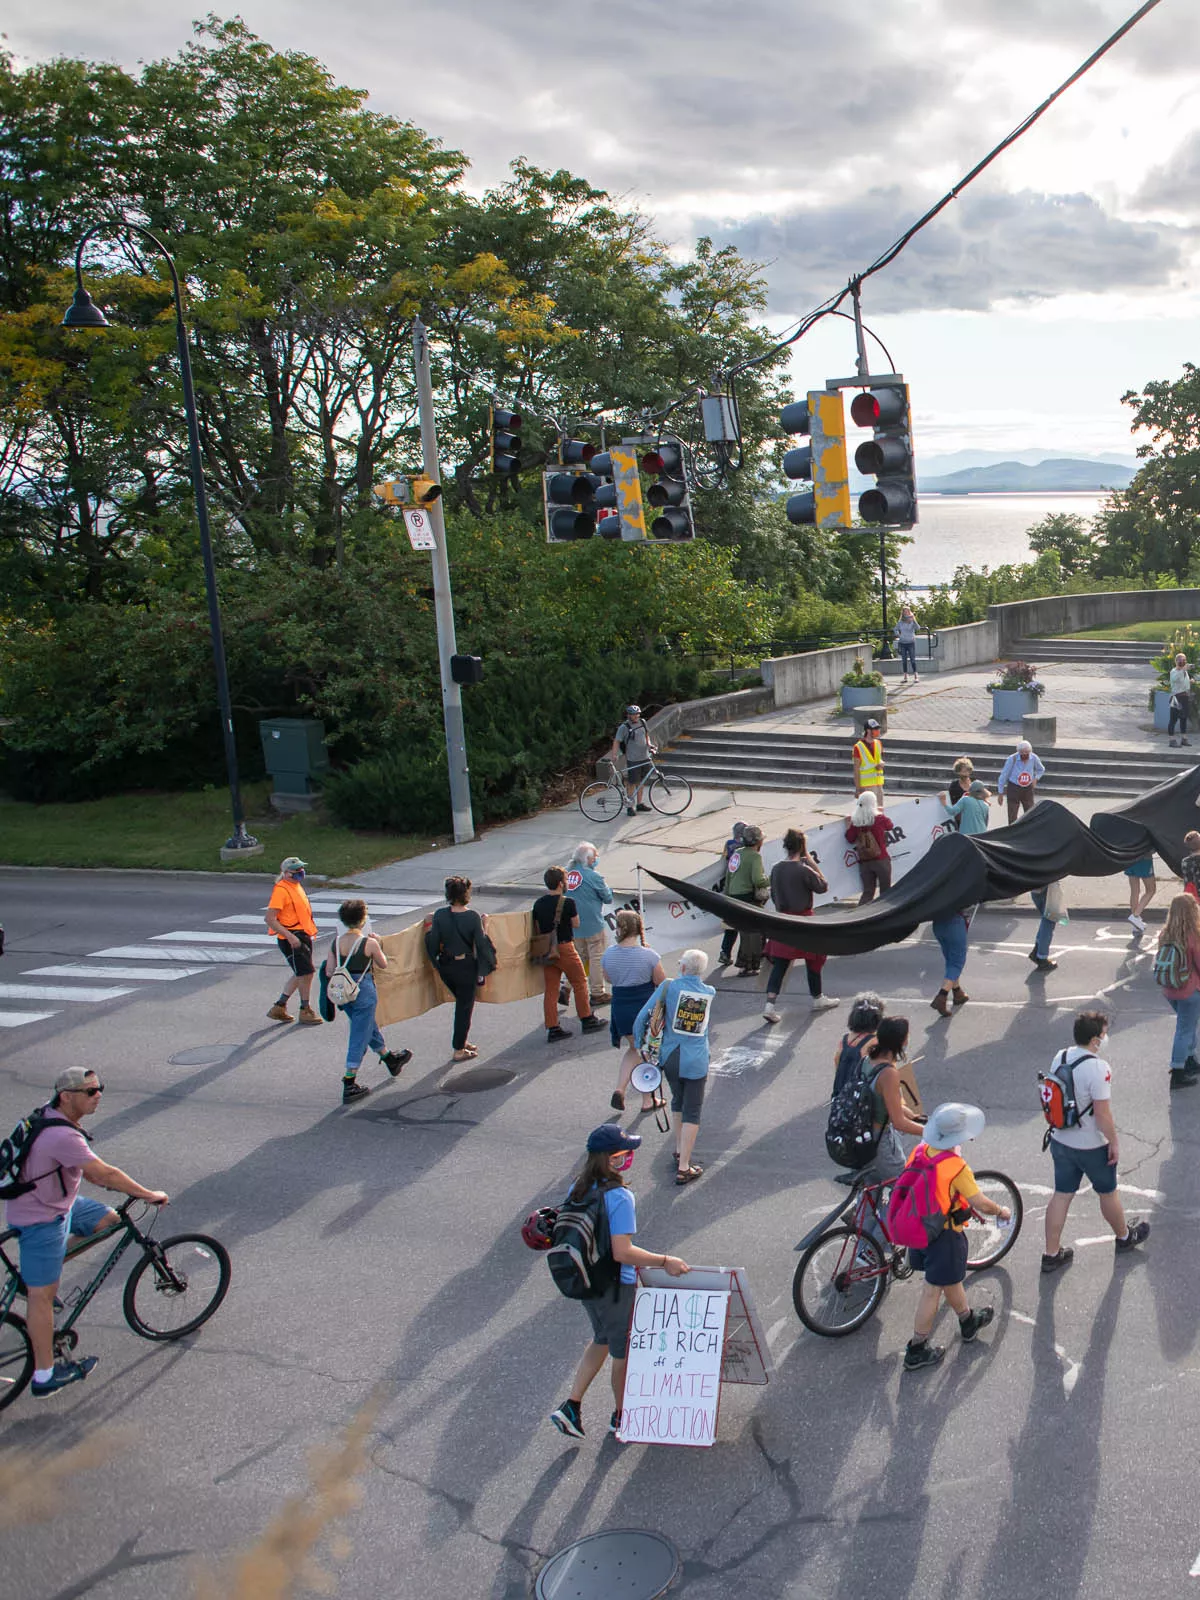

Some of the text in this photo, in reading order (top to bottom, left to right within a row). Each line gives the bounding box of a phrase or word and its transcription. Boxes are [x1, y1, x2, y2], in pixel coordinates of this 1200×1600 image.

[678, 1009, 705, 1022] DEFUND
[634, 1292, 722, 1333] CHA$E
[631, 1331, 719, 1353] GET$ RICH
[653, 1356, 685, 1369] off of
[626, 1372, 717, 1398] CLIMATE
[621, 1405, 715, 1441] DESTRUCTION
